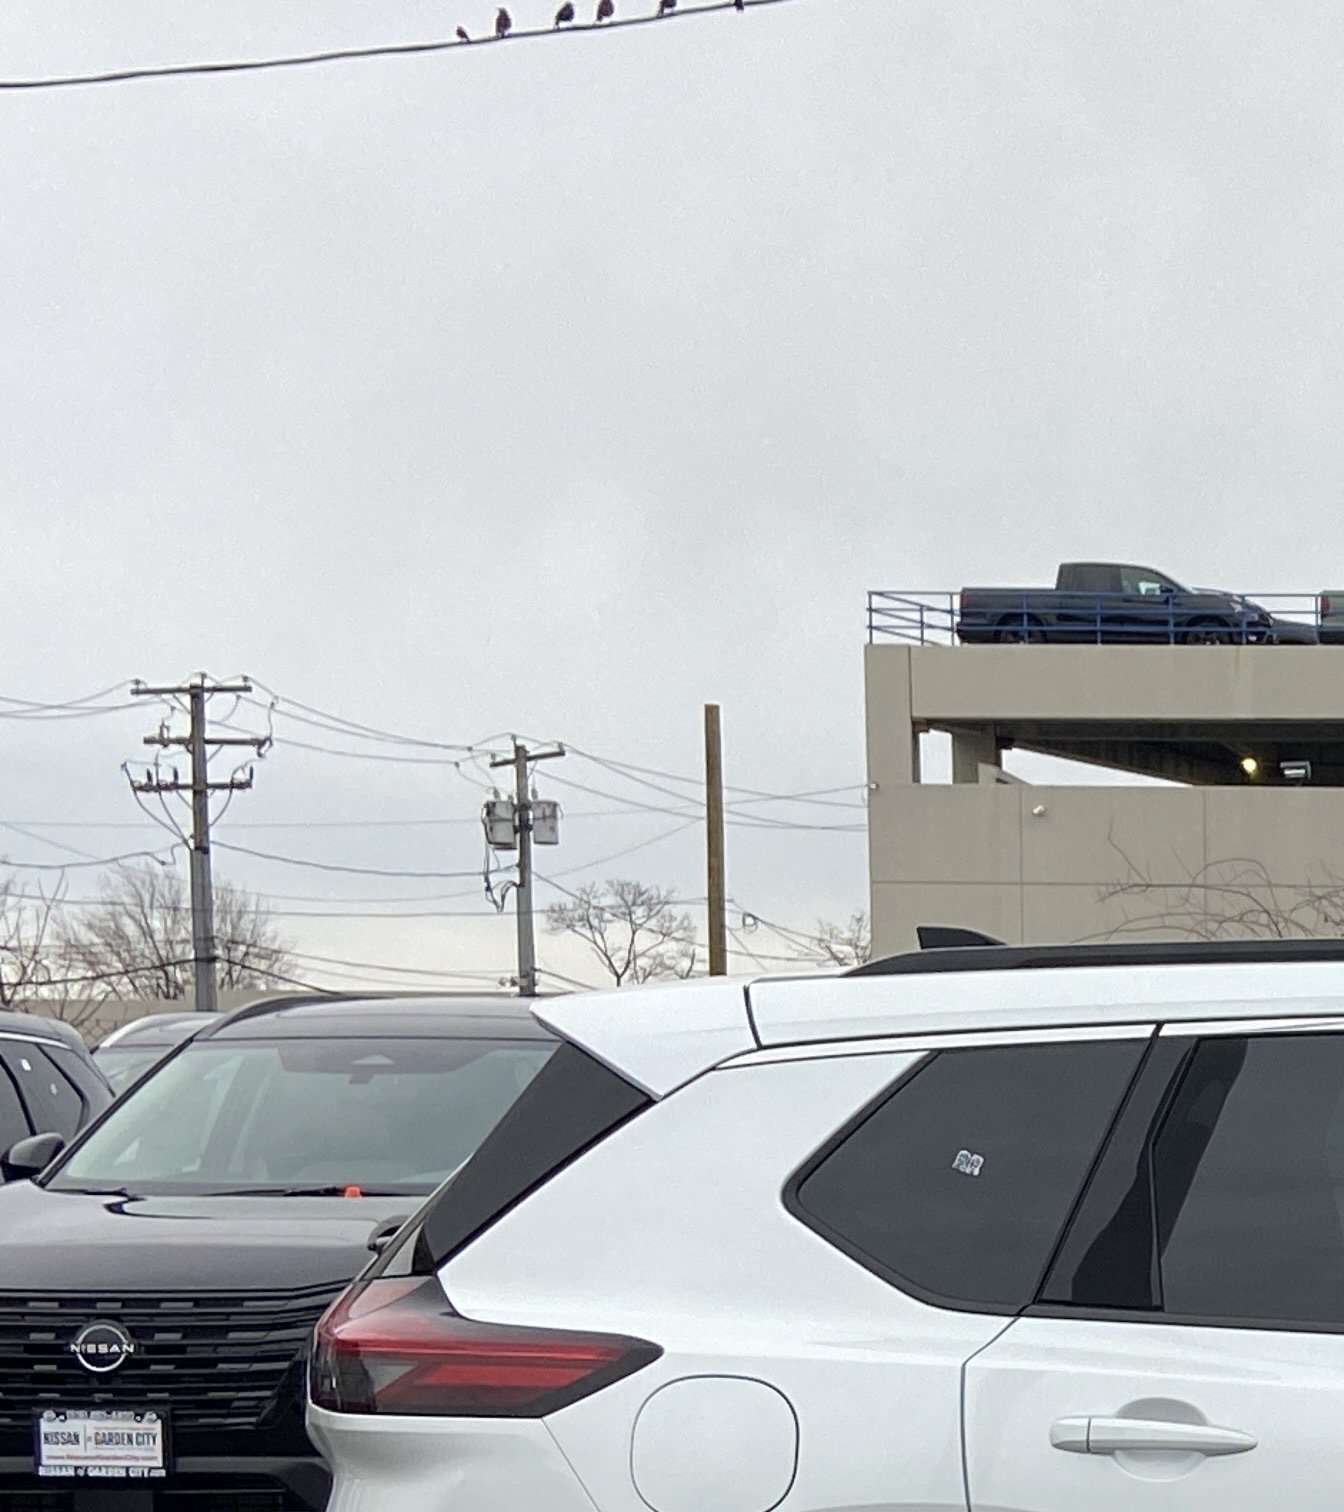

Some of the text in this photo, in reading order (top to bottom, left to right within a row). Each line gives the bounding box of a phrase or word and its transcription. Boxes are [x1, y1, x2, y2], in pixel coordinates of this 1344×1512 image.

[69, 1343, 135, 1354] NISSAN
[43, 1431, 80, 1446] NISSAN
[94, 1431, 134, 1446] GARDEN
[135, 1432, 158, 1446] CITY
